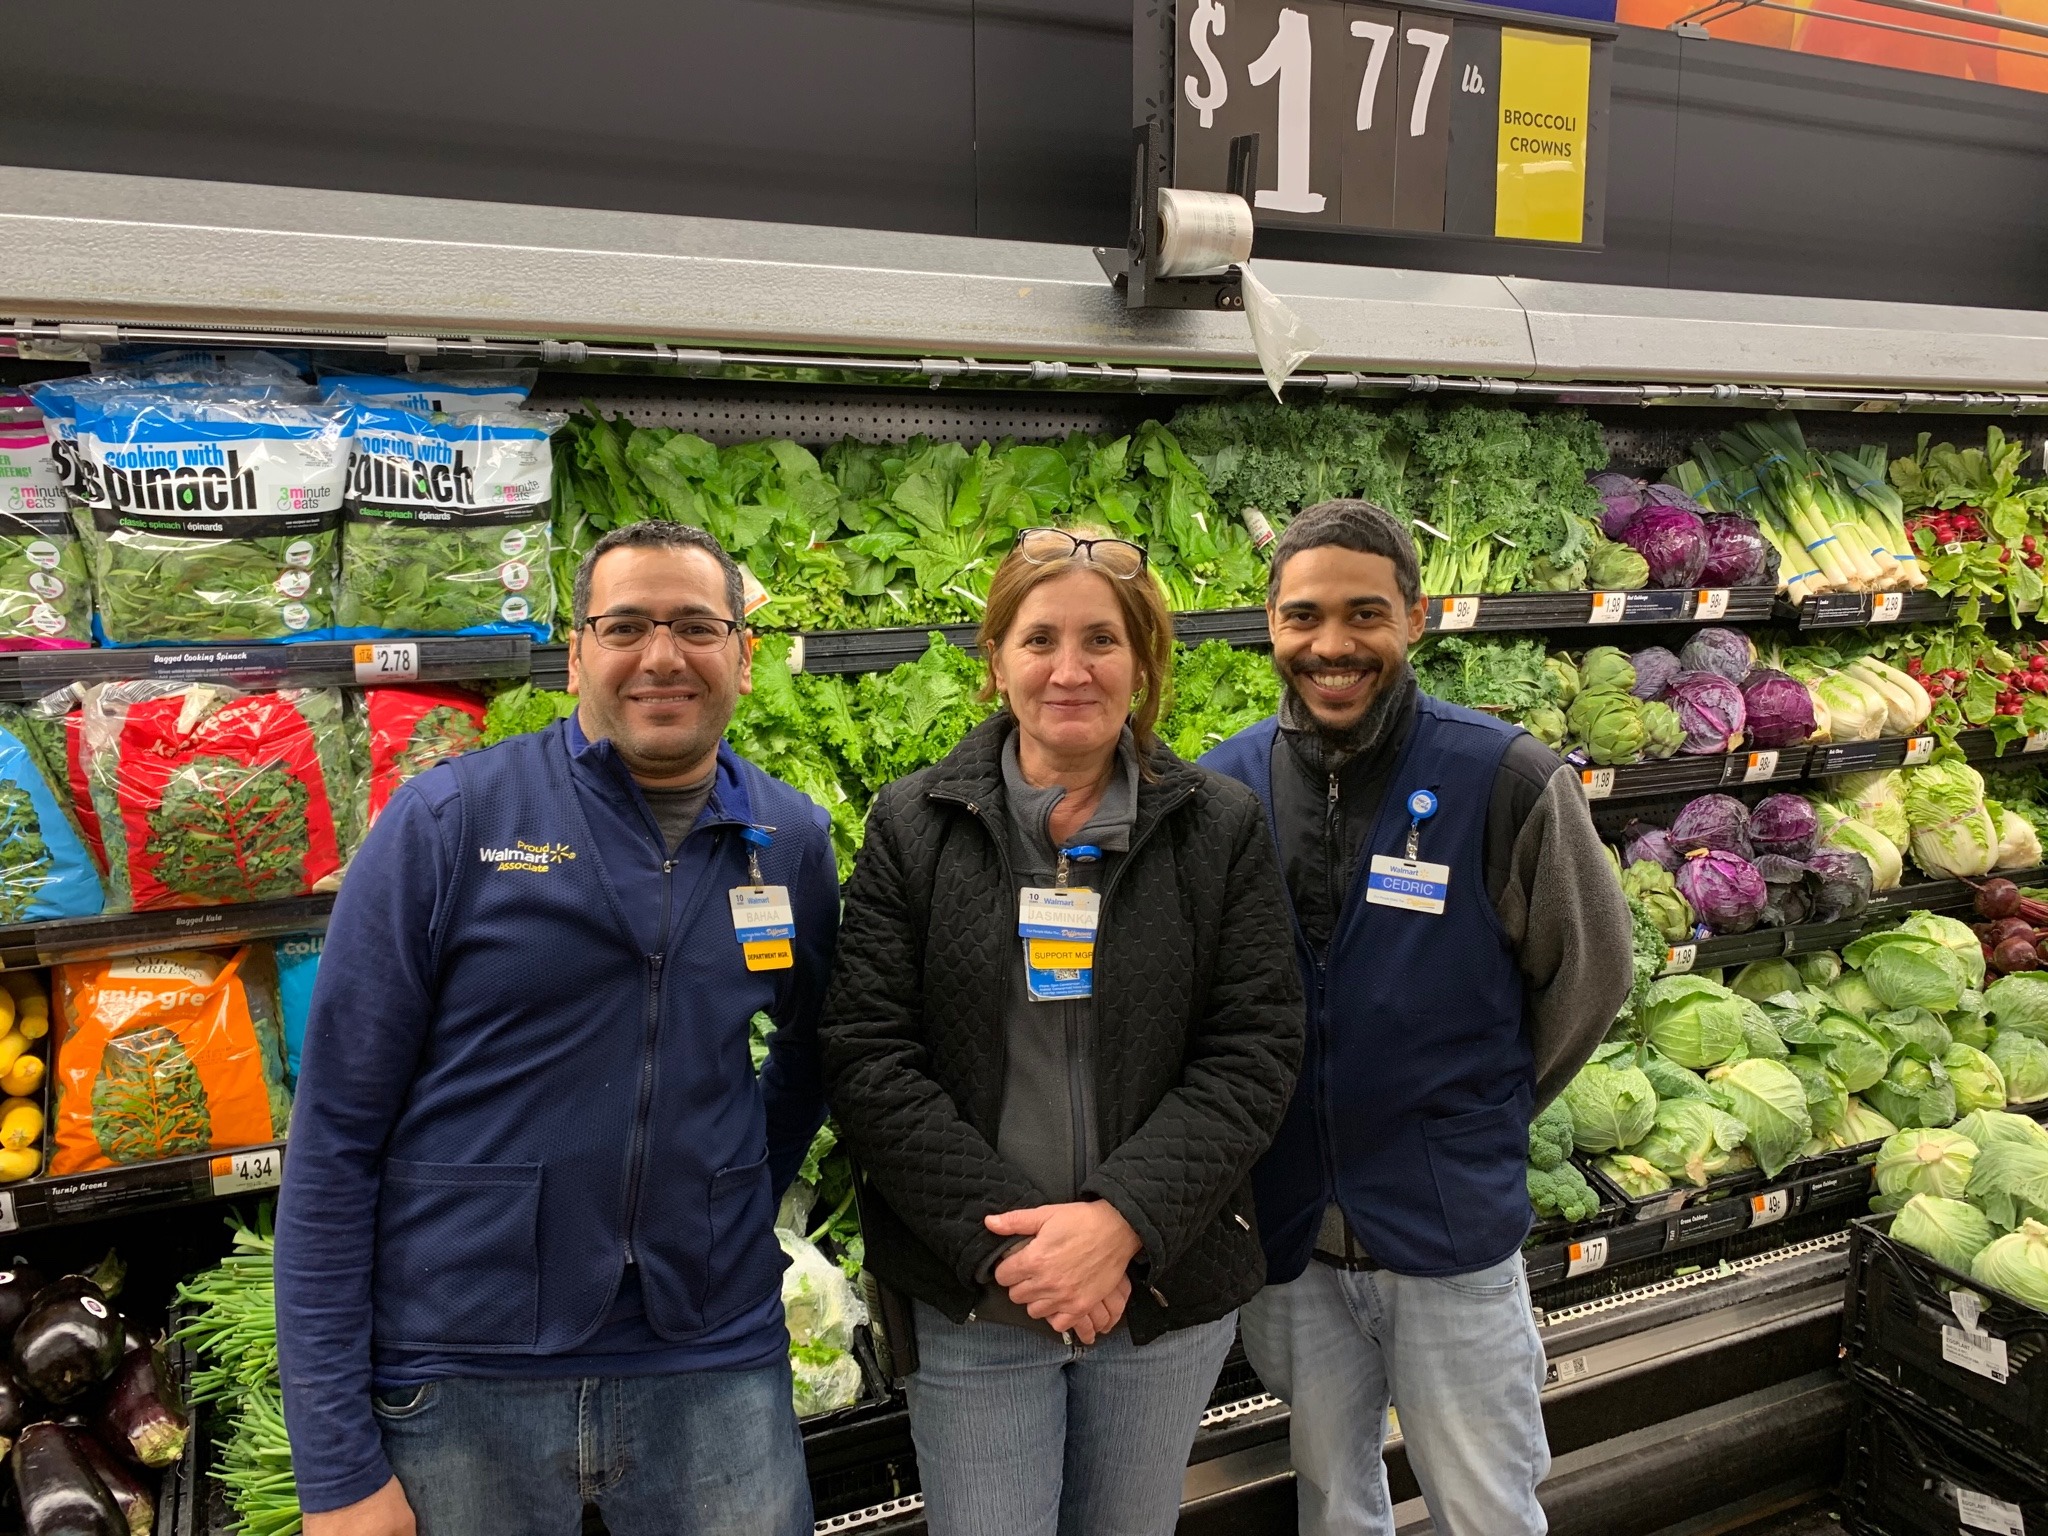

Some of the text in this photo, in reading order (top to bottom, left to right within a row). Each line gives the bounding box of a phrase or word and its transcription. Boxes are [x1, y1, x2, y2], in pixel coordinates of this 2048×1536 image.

[1461, 64, 1486, 96] lb.
[1503, 108, 1577, 132] BROCCOLI
[1509, 135, 1572, 157] CROWNS
[105, 444, 225, 470] cooking with
[418, 438, 452, 465] with
[21, 485, 66, 498] minute
[289, 485, 331, 500] minute
[503, 479, 540, 494] minute
[26, 497, 56, 508] eats
[293, 497, 319, 510] eats
[506, 491, 530, 503] eats
[360, 506, 451, 522] classic spinach épinards
[119, 517, 224, 534] classic spinach épinards
[154, 651, 247, 664] Bagged Cooking Spinach
[517, 840, 550, 854] Proud
[479, 847, 549, 864] Walmart
[497, 861, 549, 873] Associate
[1390, 865, 1419, 877] Walmart
[1383, 877, 1434, 896] CEDRIC
[736, 894, 770, 905] 10 Walmart
[1029, 893, 1074, 907] 10 Walmart
[176, 914, 222, 927] Bagged Kale
[746, 910, 780, 923] BAHAA
[1027, 909, 1094, 926] JASMINKA
[747, 953, 777, 961] DEPARTMENT
[1034, 951, 1073, 960] SUPPORT
[52, 1180, 108, 1196] Turnip Greens
